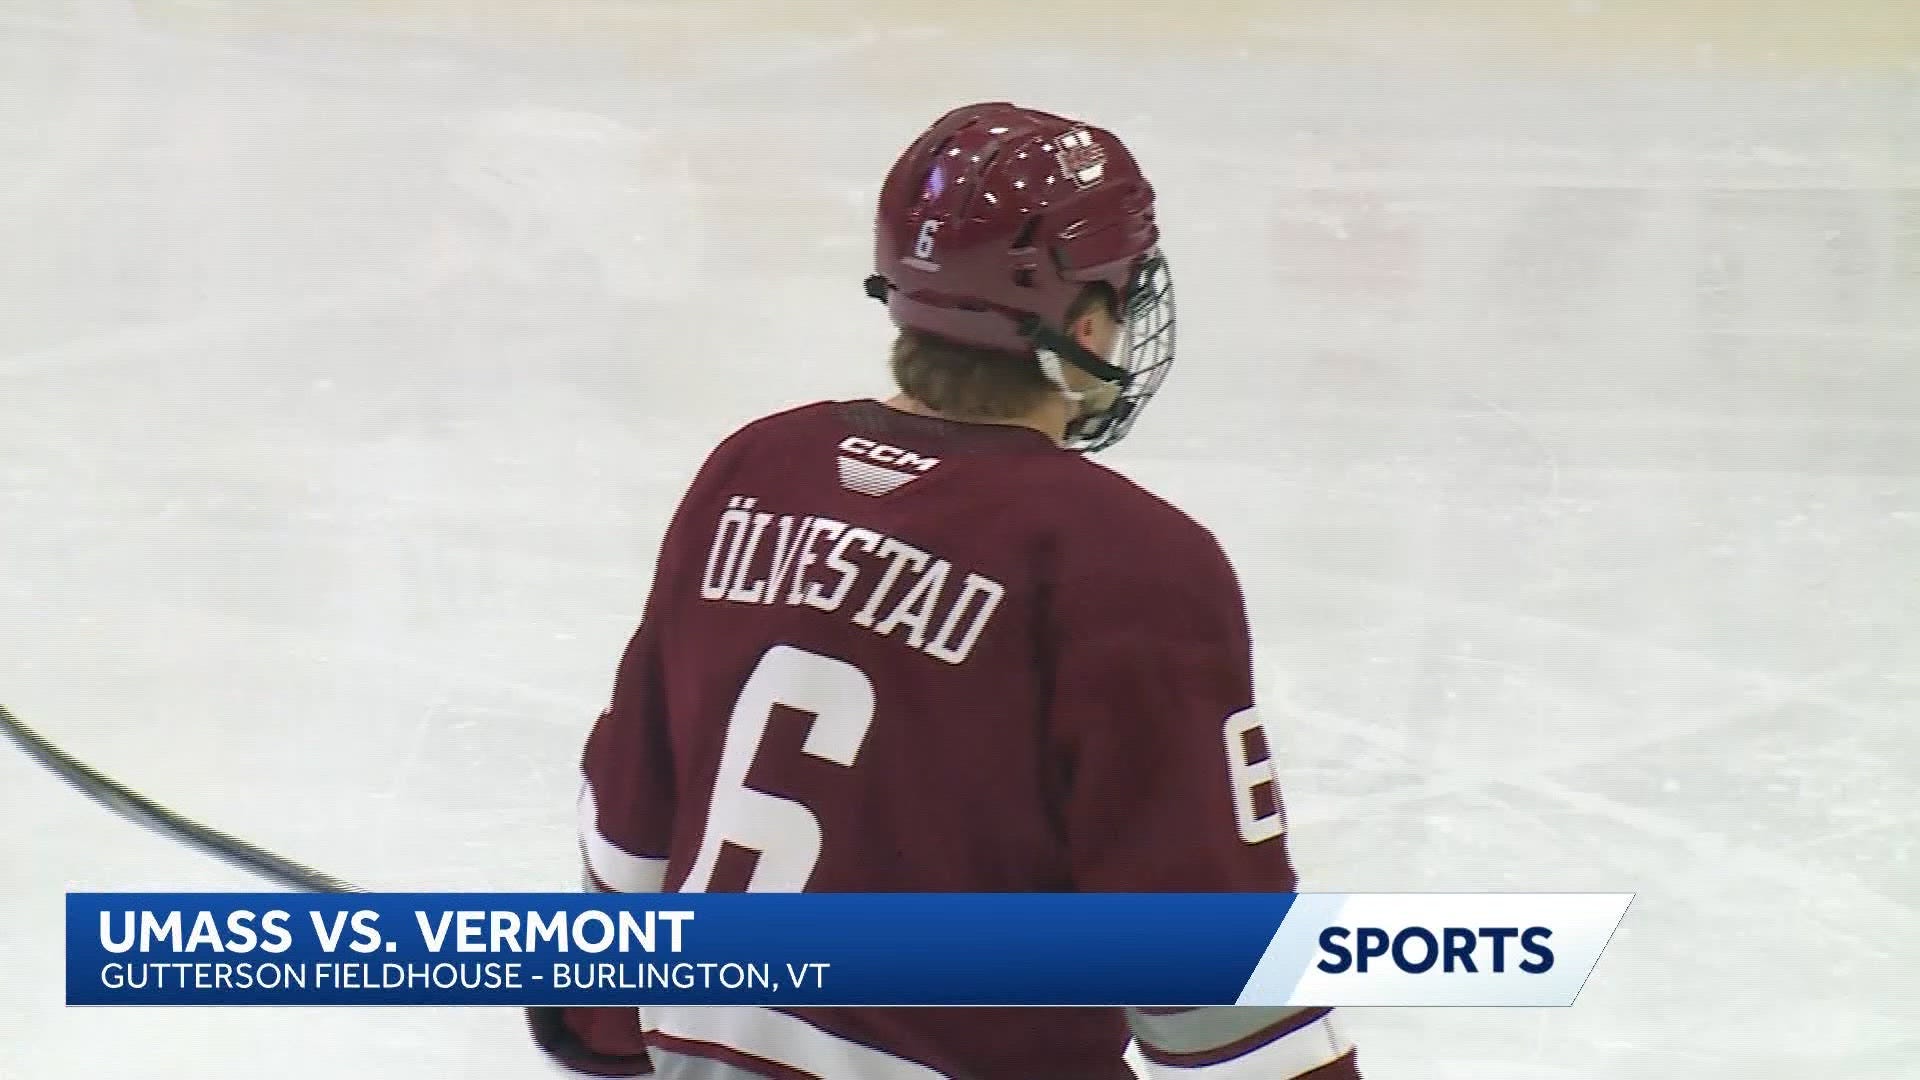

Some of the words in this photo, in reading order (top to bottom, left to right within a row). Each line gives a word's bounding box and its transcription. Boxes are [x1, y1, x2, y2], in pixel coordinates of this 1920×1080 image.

[914, 219, 941, 258] 6
[837, 436, 942, 471] CCM
[700, 495, 1006, 665] ÖLVESTAD
[678, 644, 877, 893] 6
